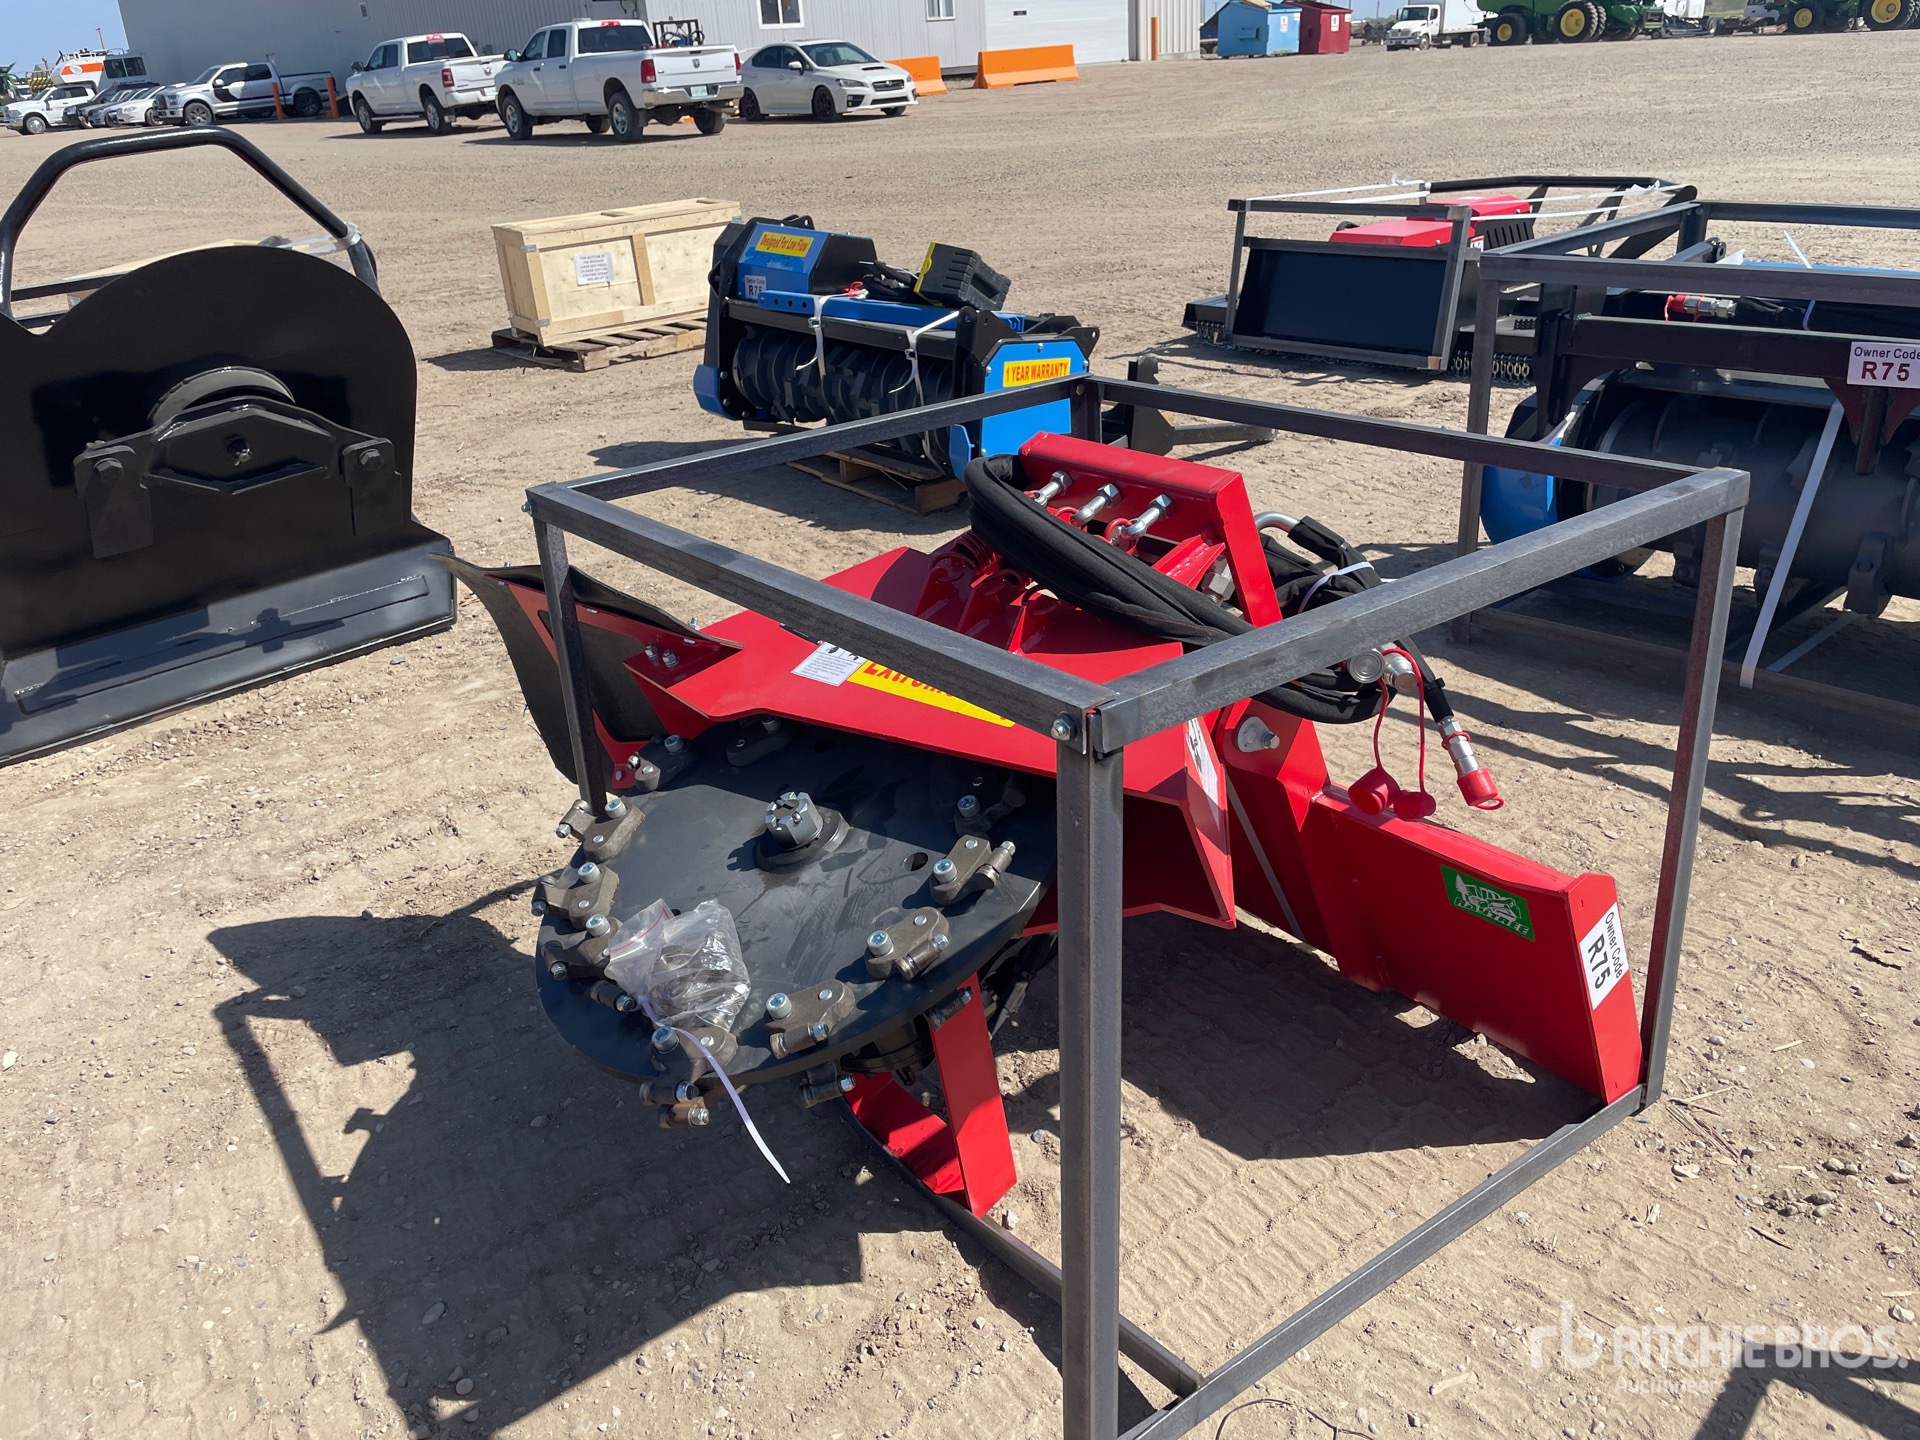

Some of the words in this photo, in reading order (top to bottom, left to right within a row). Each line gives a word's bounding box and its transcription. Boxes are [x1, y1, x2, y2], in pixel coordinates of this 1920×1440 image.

[760, 234, 782, 250] Designed
[1854, 346, 1891, 358] Owner
[1893, 348, 1920, 360] Code
[1011, 365, 1030, 382] YEAR
[1031, 362, 1068, 380] WARRANTY
[1861, 361, 1910, 382] R75
[1605, 912, 1618, 949] Owner
[1588, 934, 1611, 989] R75
[1611, 946, 1623, 979] Code
